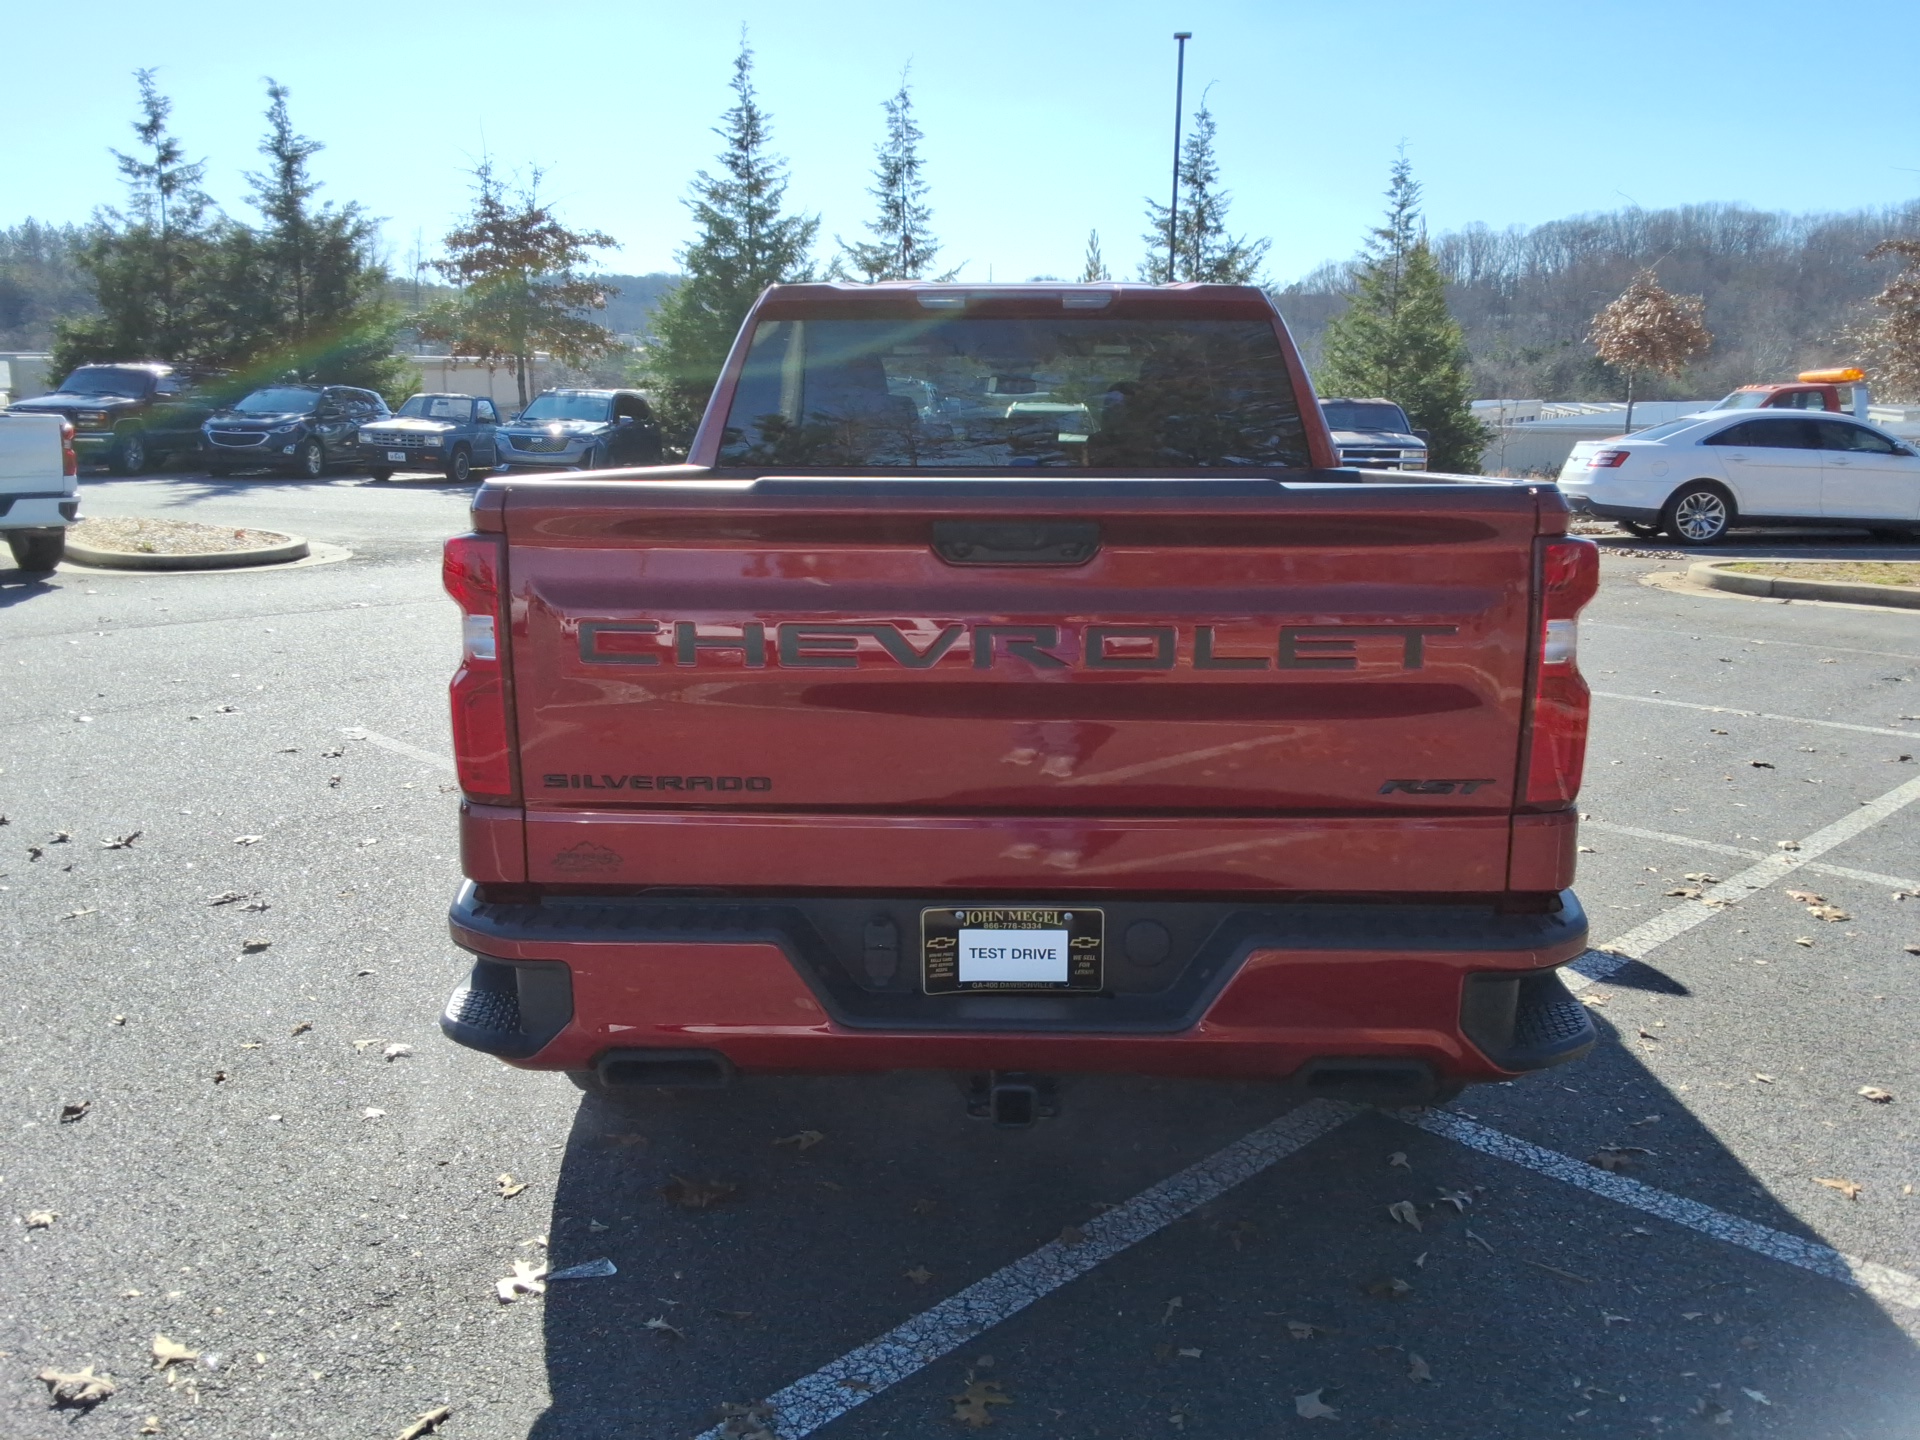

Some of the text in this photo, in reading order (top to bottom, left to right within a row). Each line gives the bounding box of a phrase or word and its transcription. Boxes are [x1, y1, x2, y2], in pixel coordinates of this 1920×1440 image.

[578, 620, 1459, 669] CHEVROLET
[542, 773, 773, 792] SILVERADO
[1377, 778, 1497, 795] RST
[963, 910, 1063, 927] JOHN MEGEL
[983, 922, 1042, 930] 866-778-3334
[969, 947, 1057, 960] TEST DRIVE
